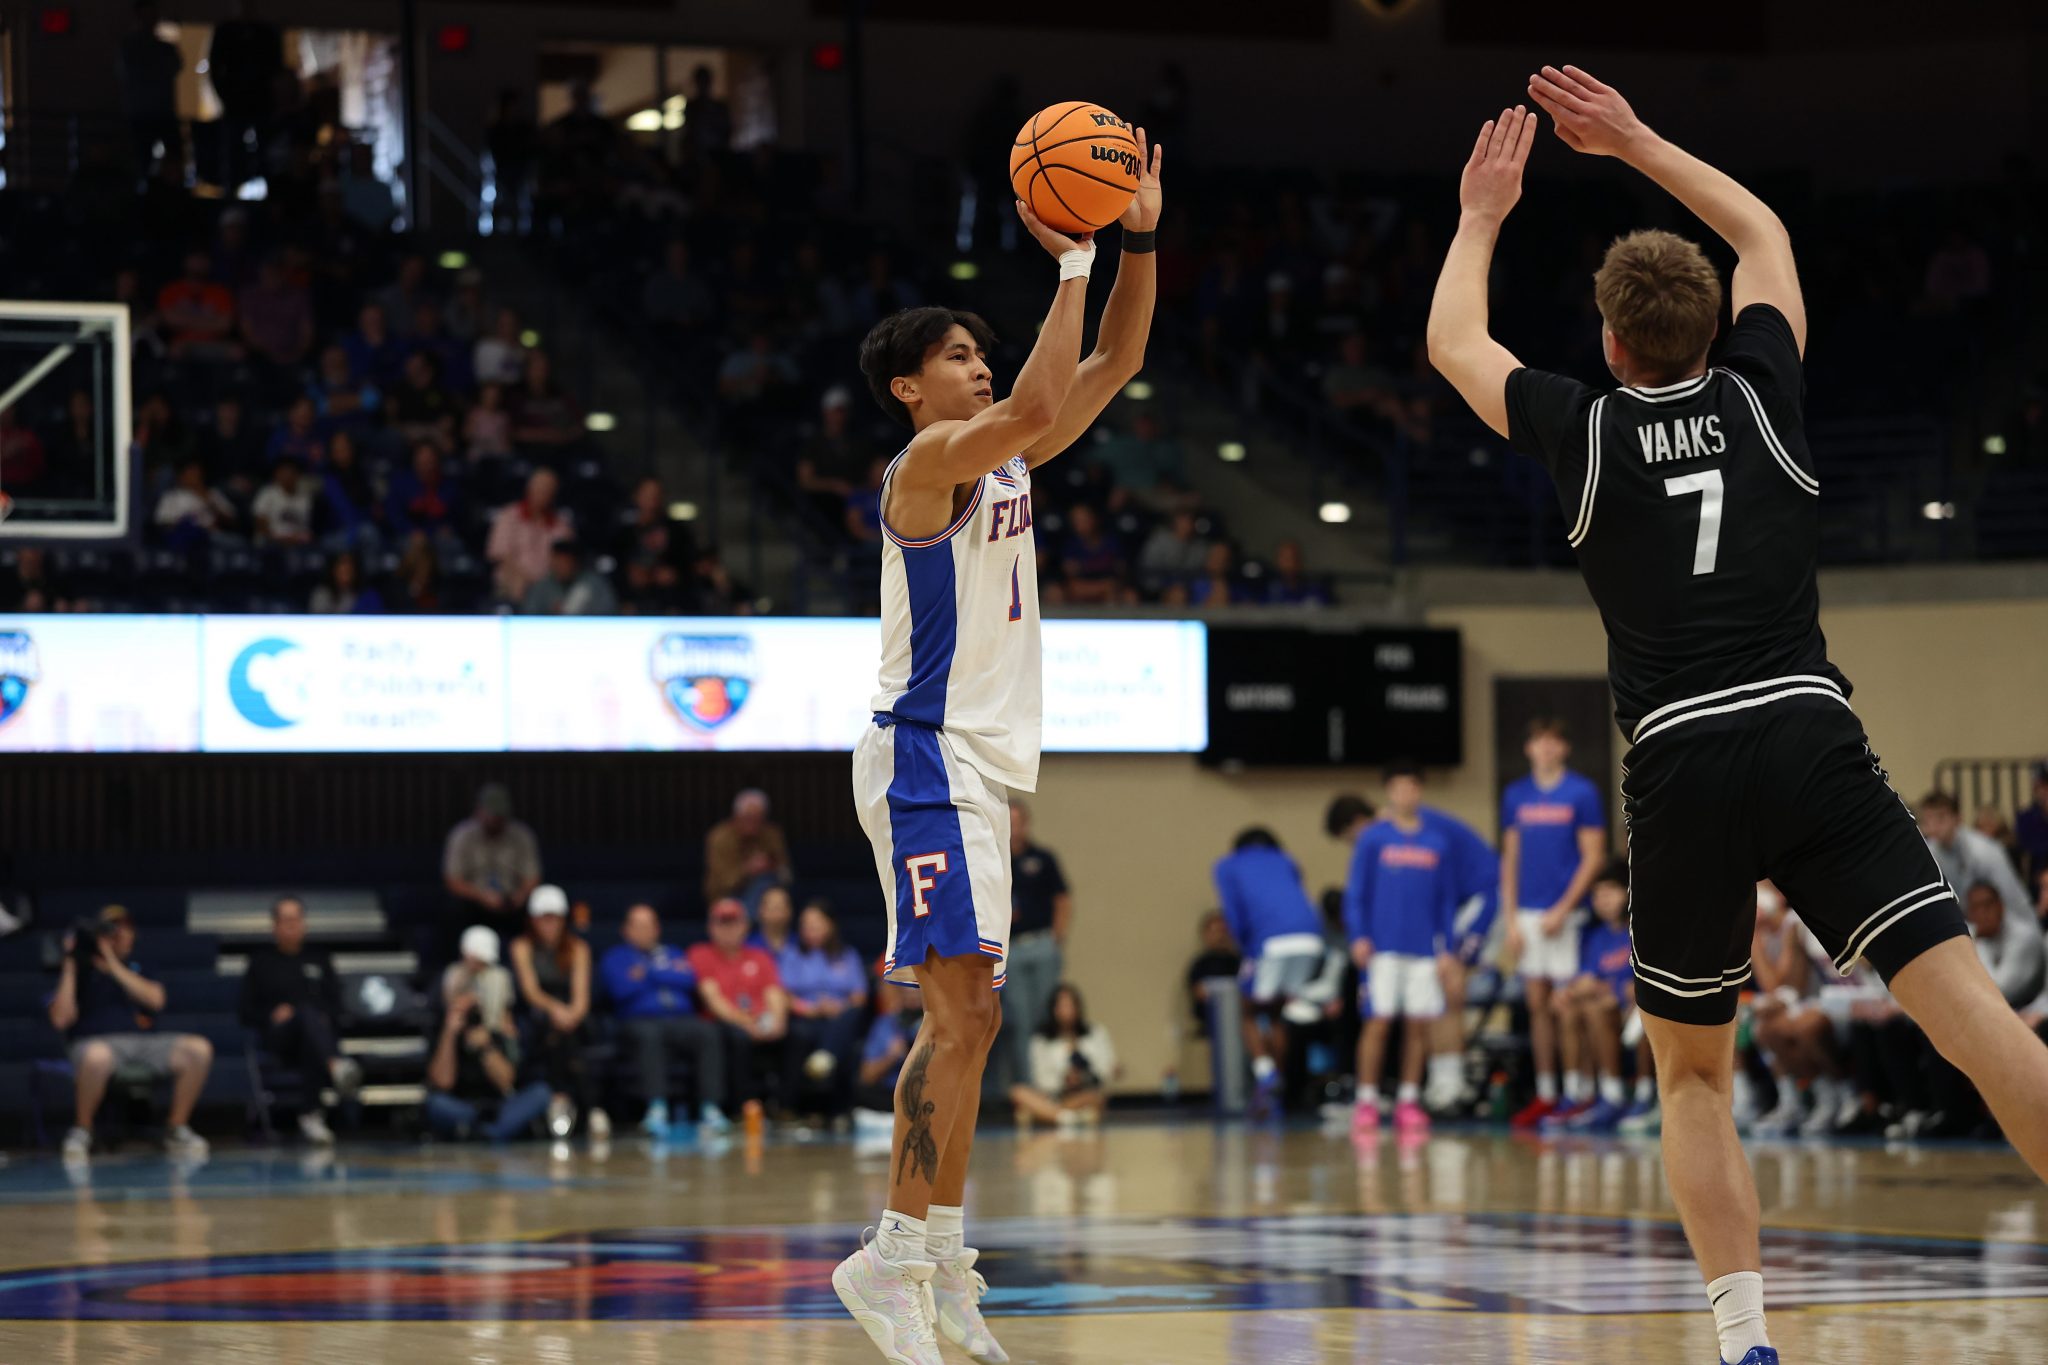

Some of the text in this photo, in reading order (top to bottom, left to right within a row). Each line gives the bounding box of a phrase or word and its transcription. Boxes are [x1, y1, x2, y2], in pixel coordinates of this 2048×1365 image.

[1090, 113, 1130, 131] CAA
[1638, 415, 1726, 463] VAAKS
[1664, 469, 1724, 575] 7
[1009, 554, 1022, 621] 1
[905, 851, 948, 919] F
